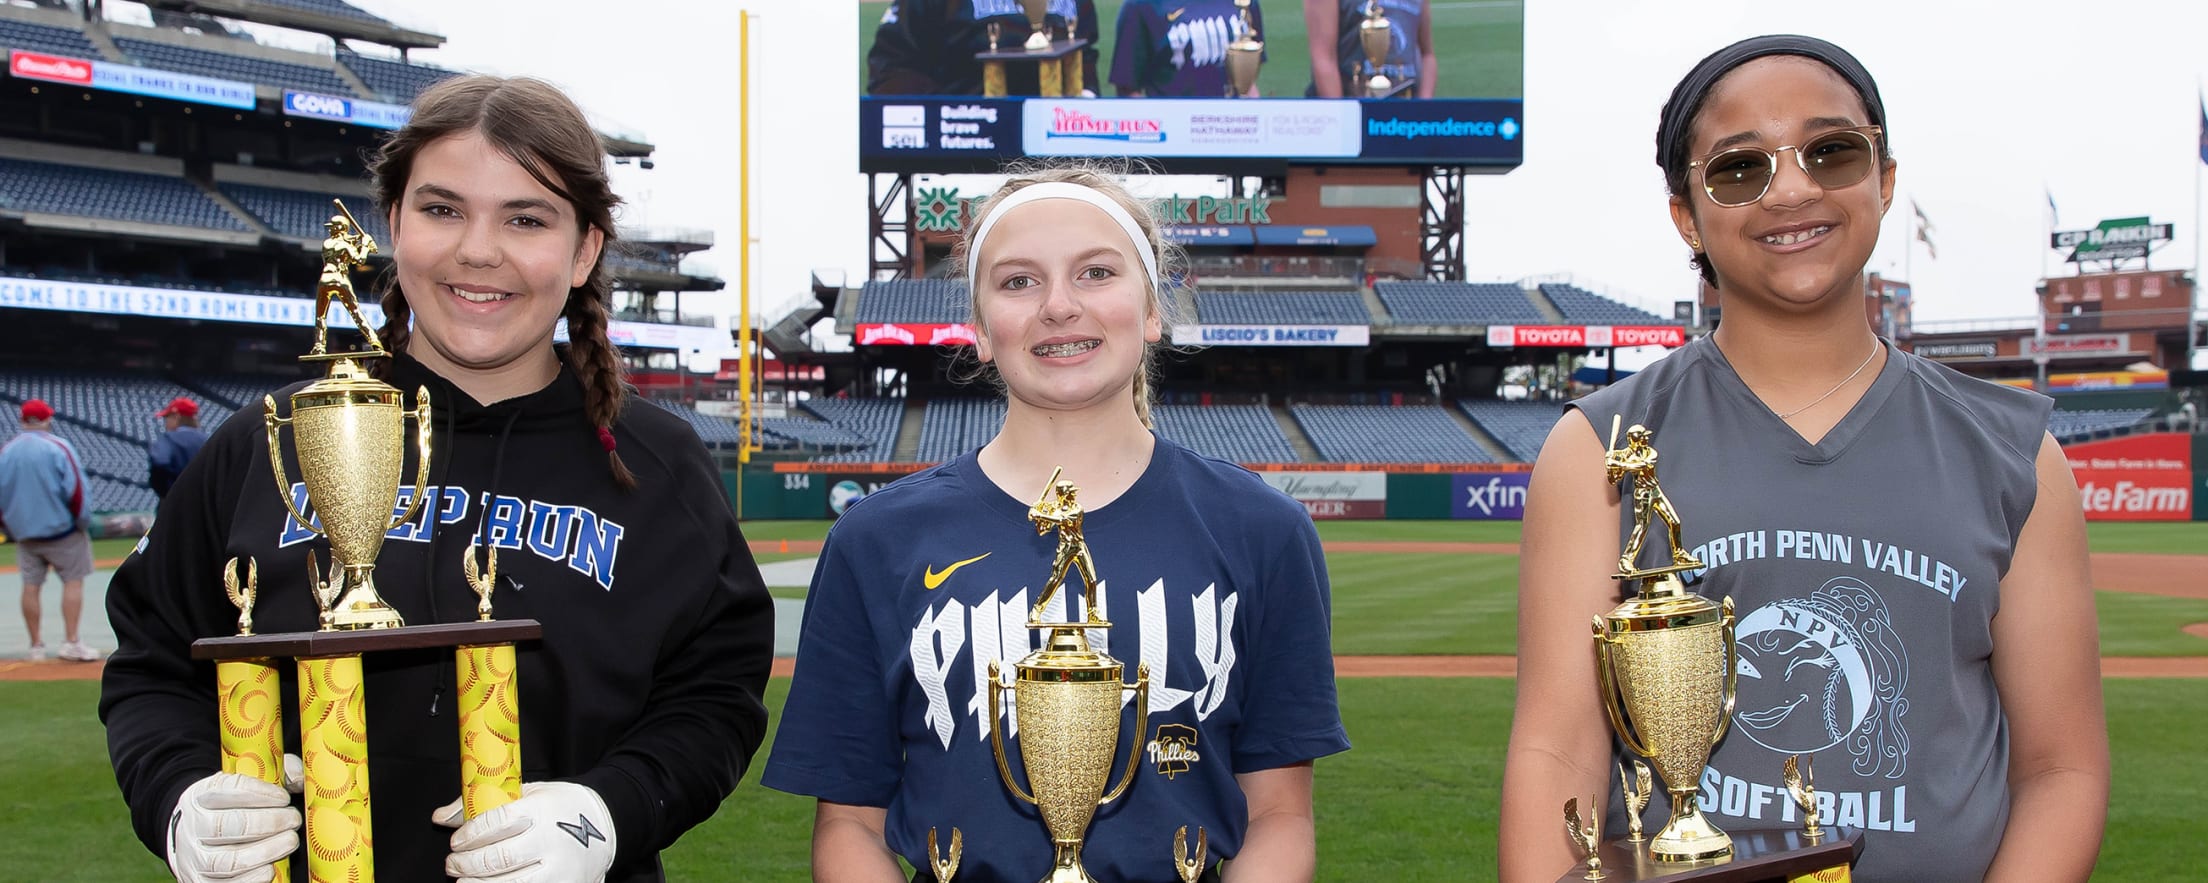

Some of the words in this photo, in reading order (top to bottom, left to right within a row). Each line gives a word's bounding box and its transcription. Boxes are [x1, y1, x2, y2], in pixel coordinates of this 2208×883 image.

[941, 105, 998, 123] Building
[1054, 119, 1114, 133] HOME
[1118, 119, 1160, 133] RUN
[941, 120, 979, 134] brave
[1368, 117, 1496, 141] Independence
[1197, 193, 1271, 224] Park
[1202, 328, 1270, 342] LISCIO'S
[1274, 328, 1338, 342] BAKERY
[1518, 329, 1583, 343] TOYOTA
[1616, 329, 1681, 344] TOYOTA
[784, 473, 810, 490] 334
[1304, 502, 1345, 515] AGER
[1466, 478, 1525, 516] xfin
[2080, 481, 2188, 512] teFarm
[279, 482, 470, 548] DEP
[471, 492, 624, 591] RUN
[1776, 530, 1852, 564] PENN
[1862, 539, 1968, 602] VALLEY
[1780, 608, 1848, 650] NPV
[1147, 739, 1200, 764] Phillies
[1697, 765, 1915, 833] SOFTBALL
